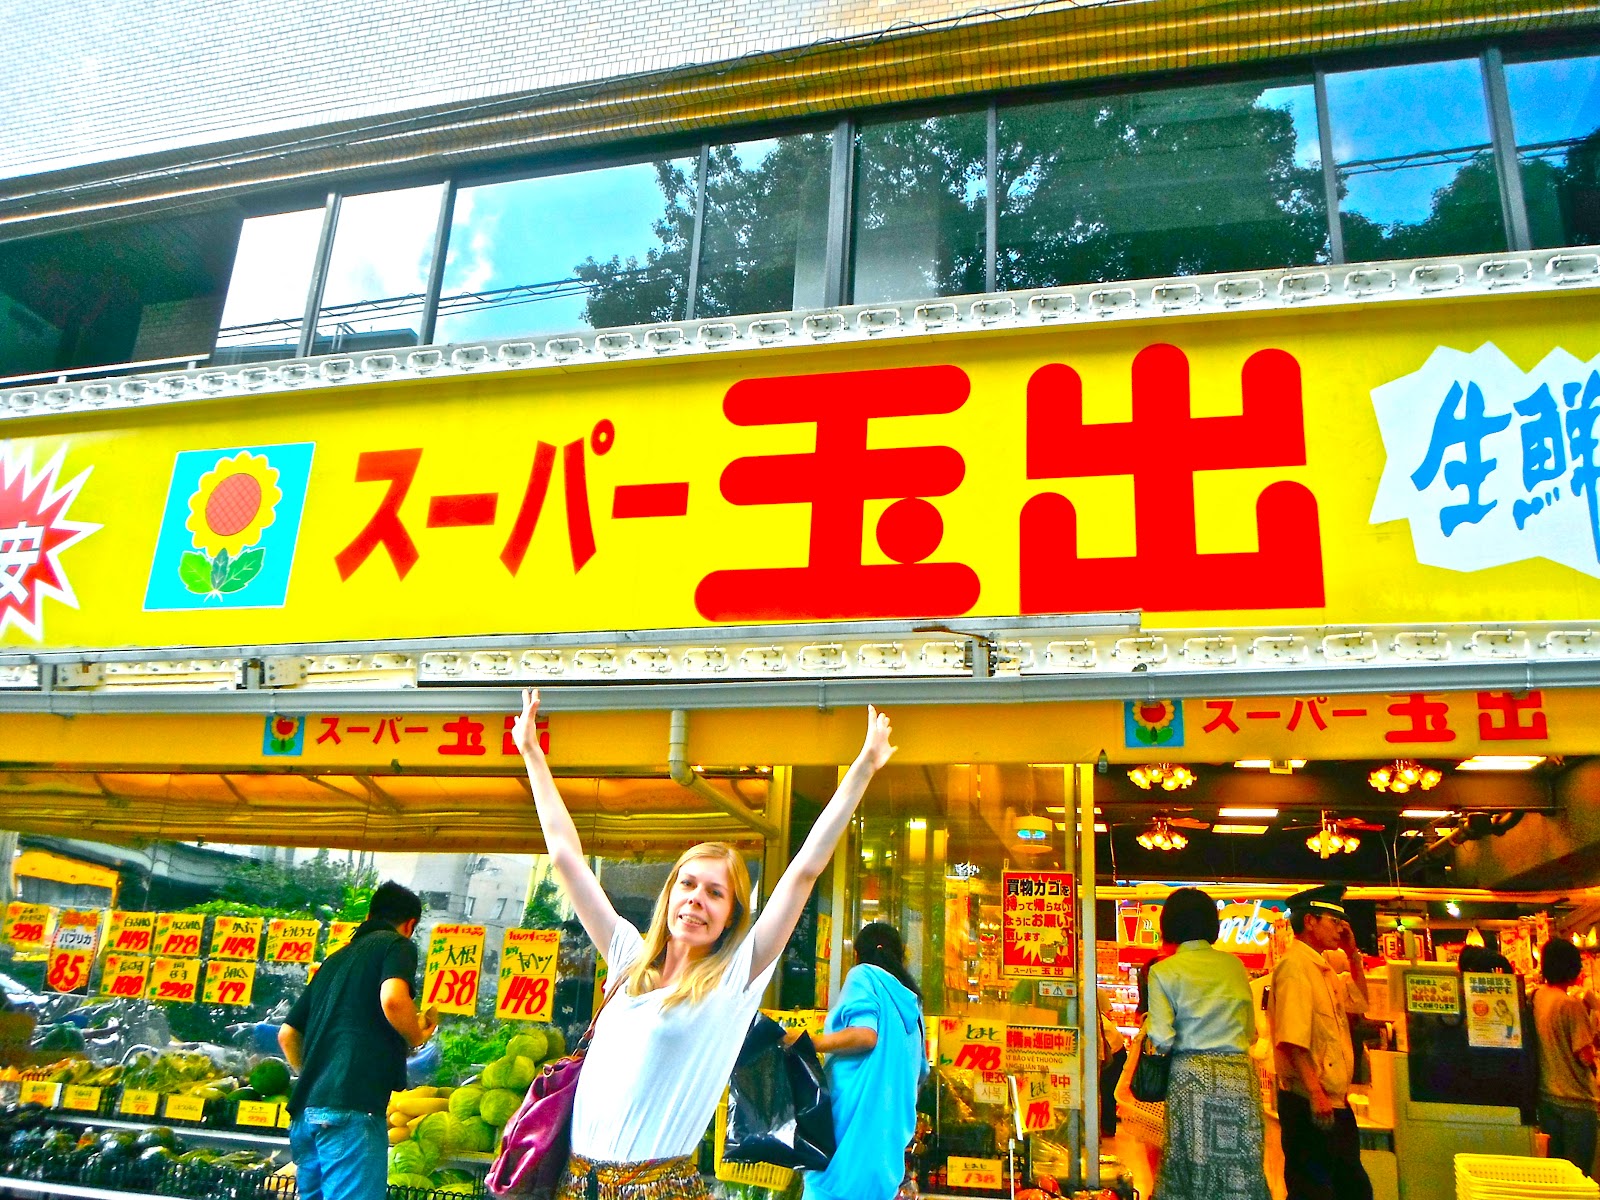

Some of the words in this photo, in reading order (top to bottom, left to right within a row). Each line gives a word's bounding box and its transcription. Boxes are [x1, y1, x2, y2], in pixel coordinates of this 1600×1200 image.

[1006, 879, 1071, 896] 買物カゴを
[1006, 896, 1071, 912] 持って帰らない
[1005, 914, 1070, 928] ようにお願い
[444, 944, 477, 967] 大根
[49, 953, 84, 987] 85
[217, 980, 246, 1003] 79
[427, 970, 478, 1006] 138
[500, 975, 549, 1015] 148
[966, 1024, 1001, 1041] とまと
[954, 1043, 1002, 1071] 198
